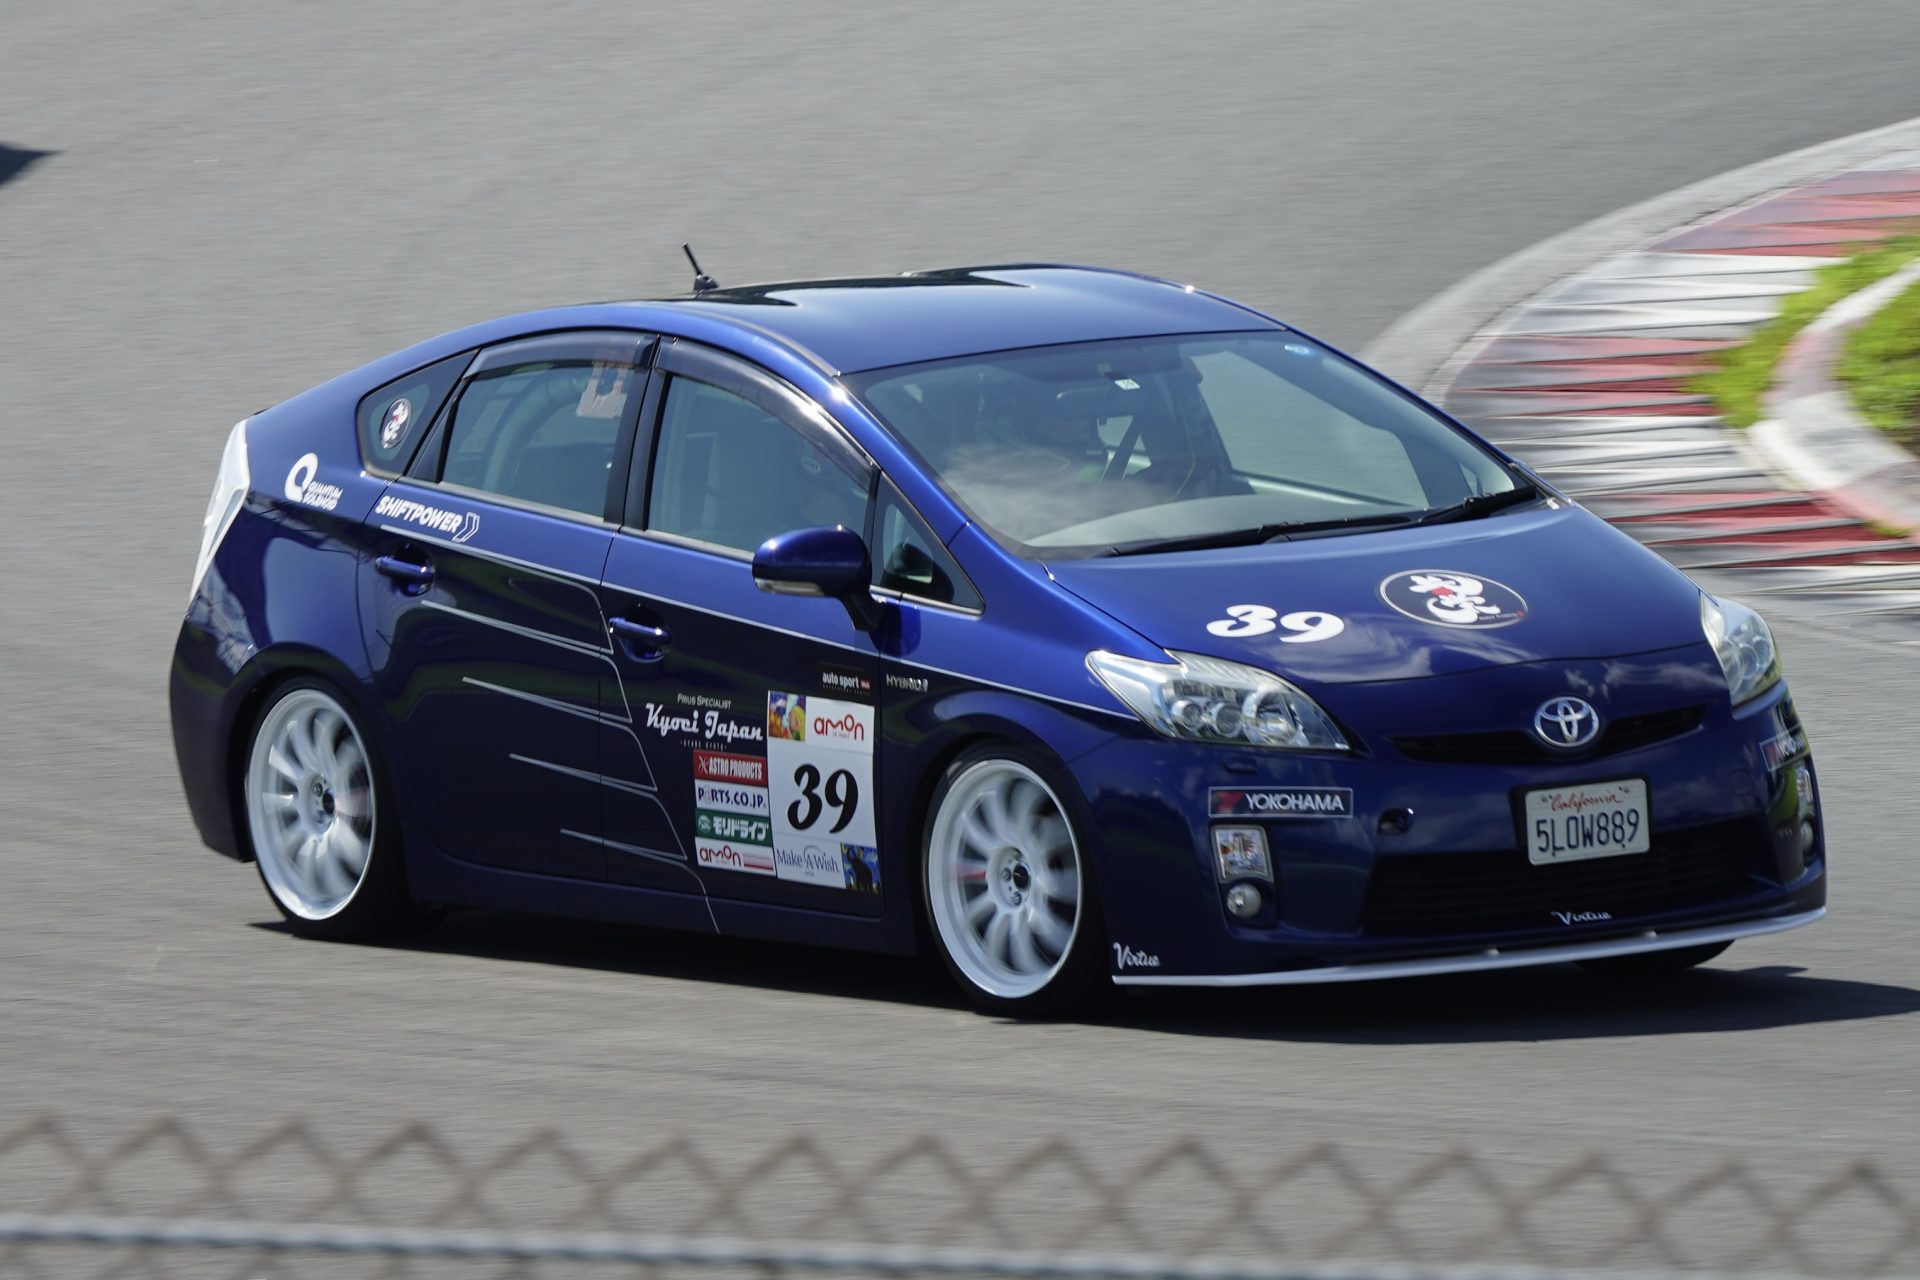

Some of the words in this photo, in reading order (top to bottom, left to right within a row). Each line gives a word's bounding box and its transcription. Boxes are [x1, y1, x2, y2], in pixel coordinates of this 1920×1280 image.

[374, 495, 463, 533] SHIFTPOWER
[1206, 604, 1346, 644] 39
[822, 672, 839, 684] auto
[840, 676, 860, 690] sport
[704, 710, 764, 743] Japan
[813, 714, 865, 742] amon
[708, 756, 729, 777] ASTRO
[729, 759, 763, 780] PRODUCTS
[787, 763, 859, 835] 39
[1245, 792, 1345, 812] YOKOHAMA
[712, 815, 770, 842] モリドライブ
[1535, 808, 1640, 853] 5LOW889
[699, 844, 742, 867] amon
[1550, 910, 1613, 926] Virtue
[1112, 942, 1161, 970] Virtue
